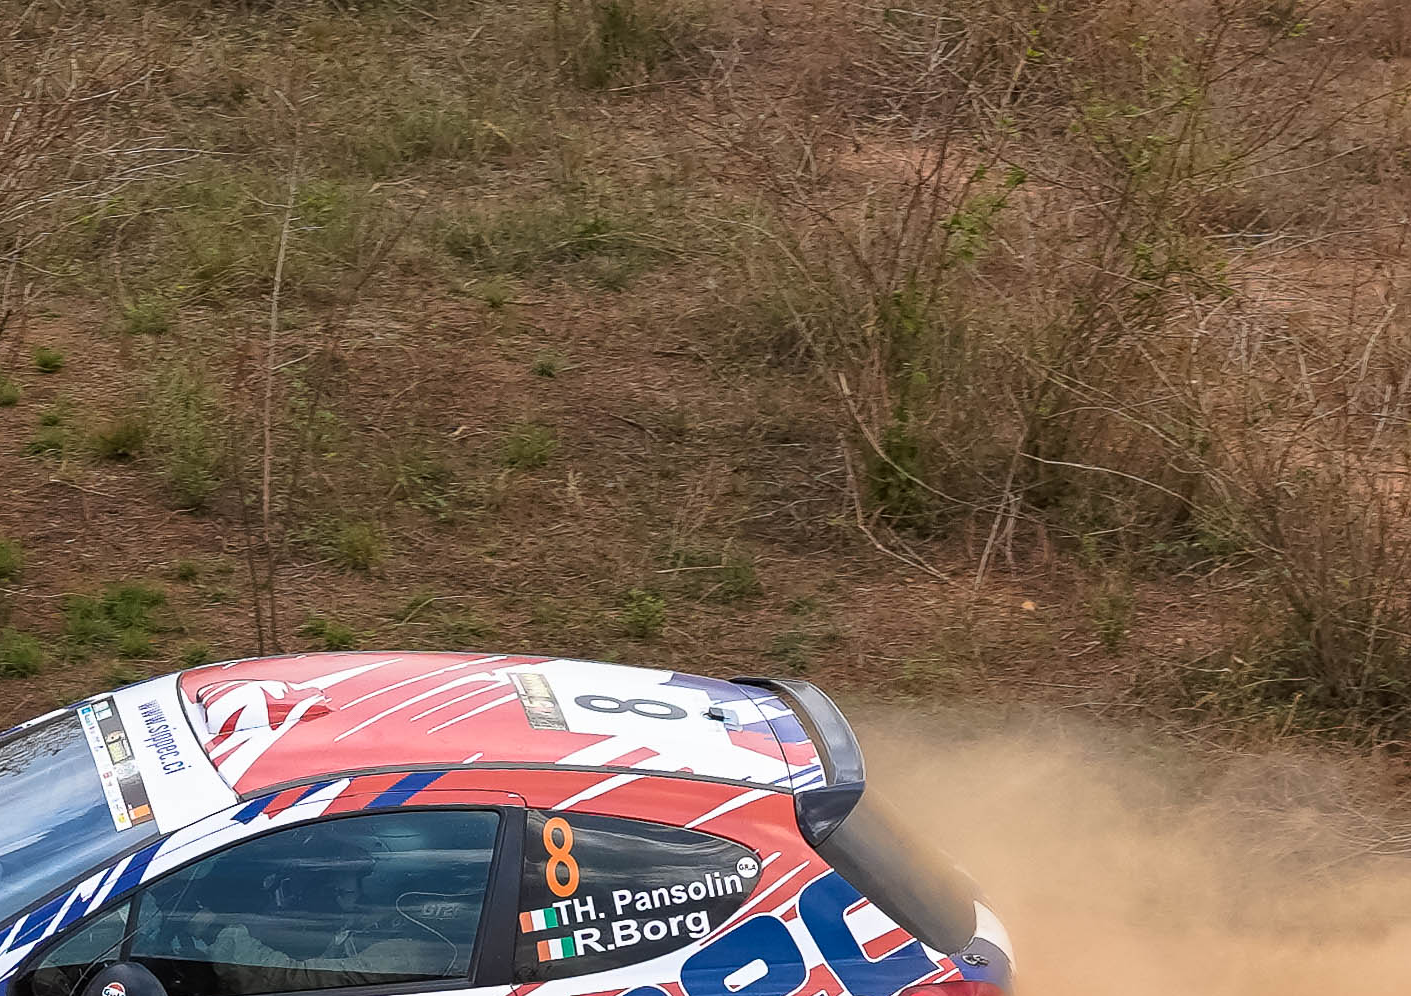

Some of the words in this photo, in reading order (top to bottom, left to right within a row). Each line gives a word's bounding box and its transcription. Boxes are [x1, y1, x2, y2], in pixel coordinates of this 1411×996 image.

[138, 699, 192, 775] www.sippec.ci
[543, 816, 580, 898] 8
[552, 896, 606, 926] TH.
[612, 871, 743, 917] Pansolin
[573, 910, 711, 956] R.Borg
